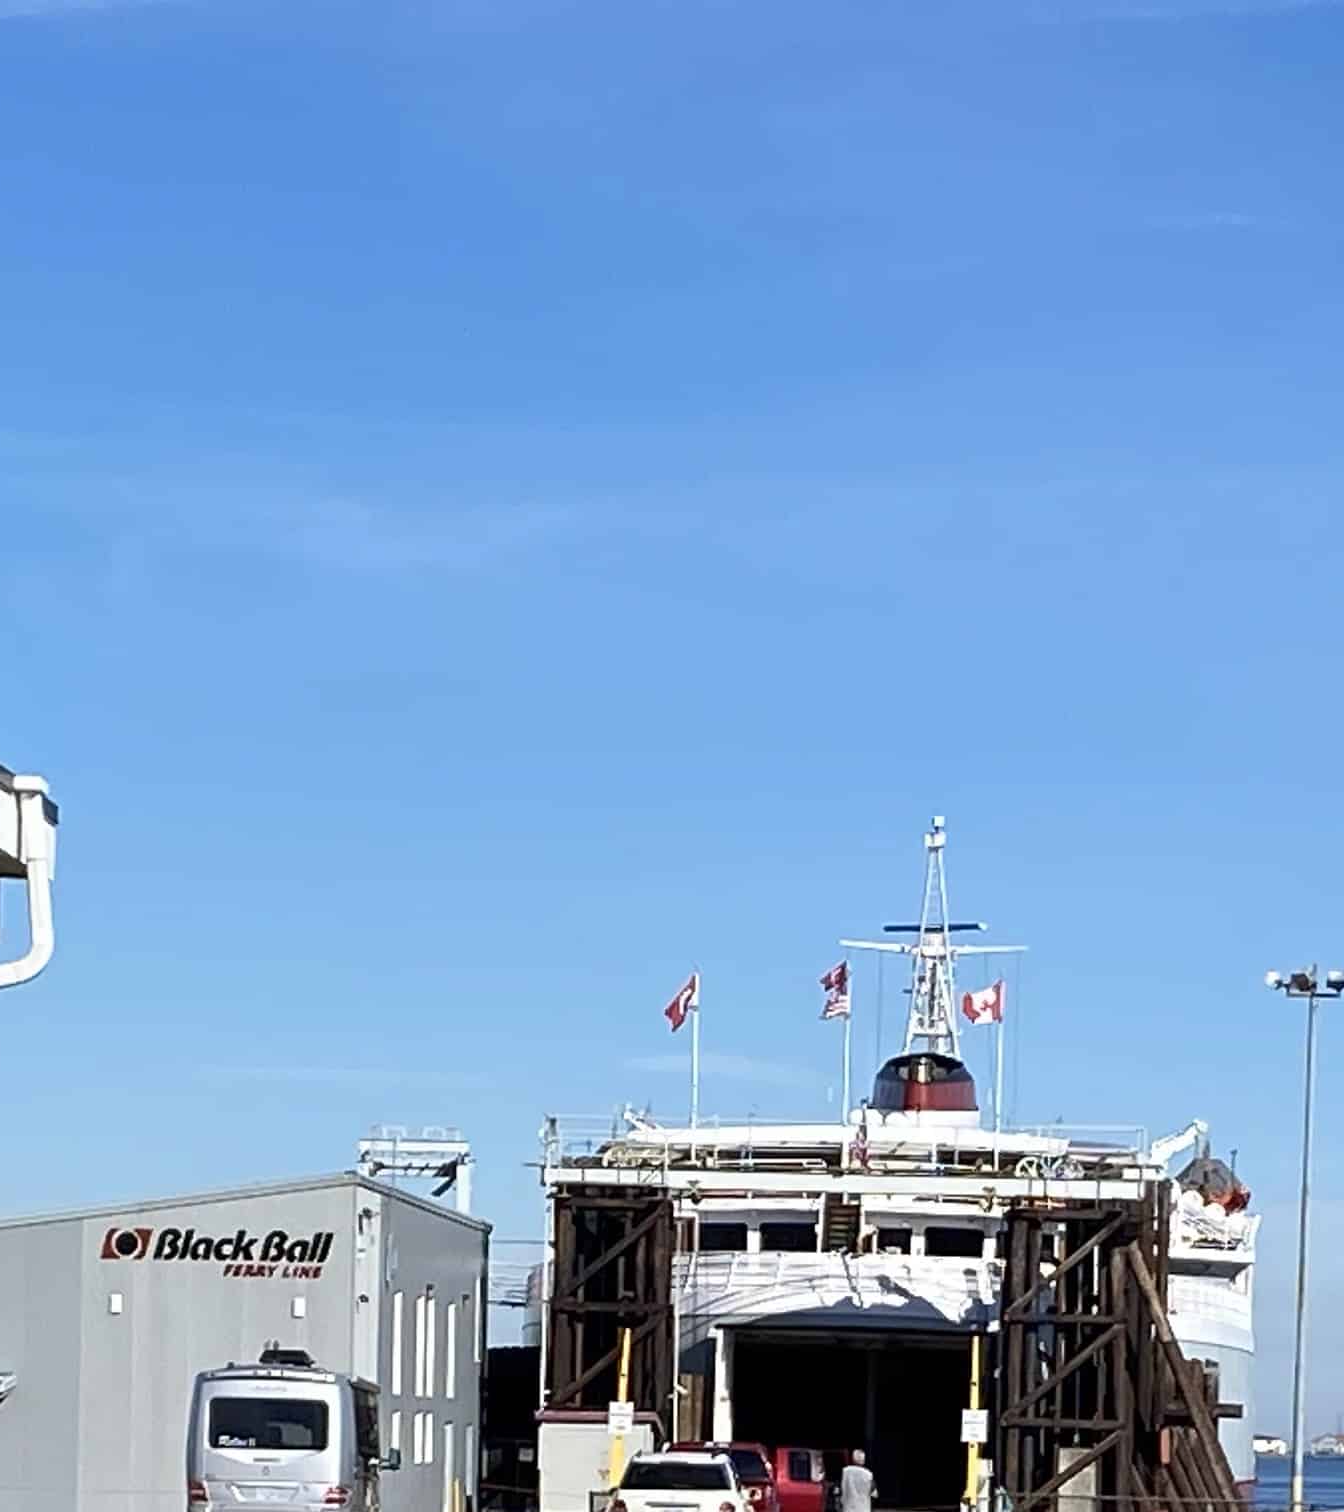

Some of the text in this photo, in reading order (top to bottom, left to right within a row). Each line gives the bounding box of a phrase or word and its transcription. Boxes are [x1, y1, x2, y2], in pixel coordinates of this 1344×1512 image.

[153, 1229, 334, 1263] Black Ball
[223, 1264, 322, 1279] FERRY LINE
